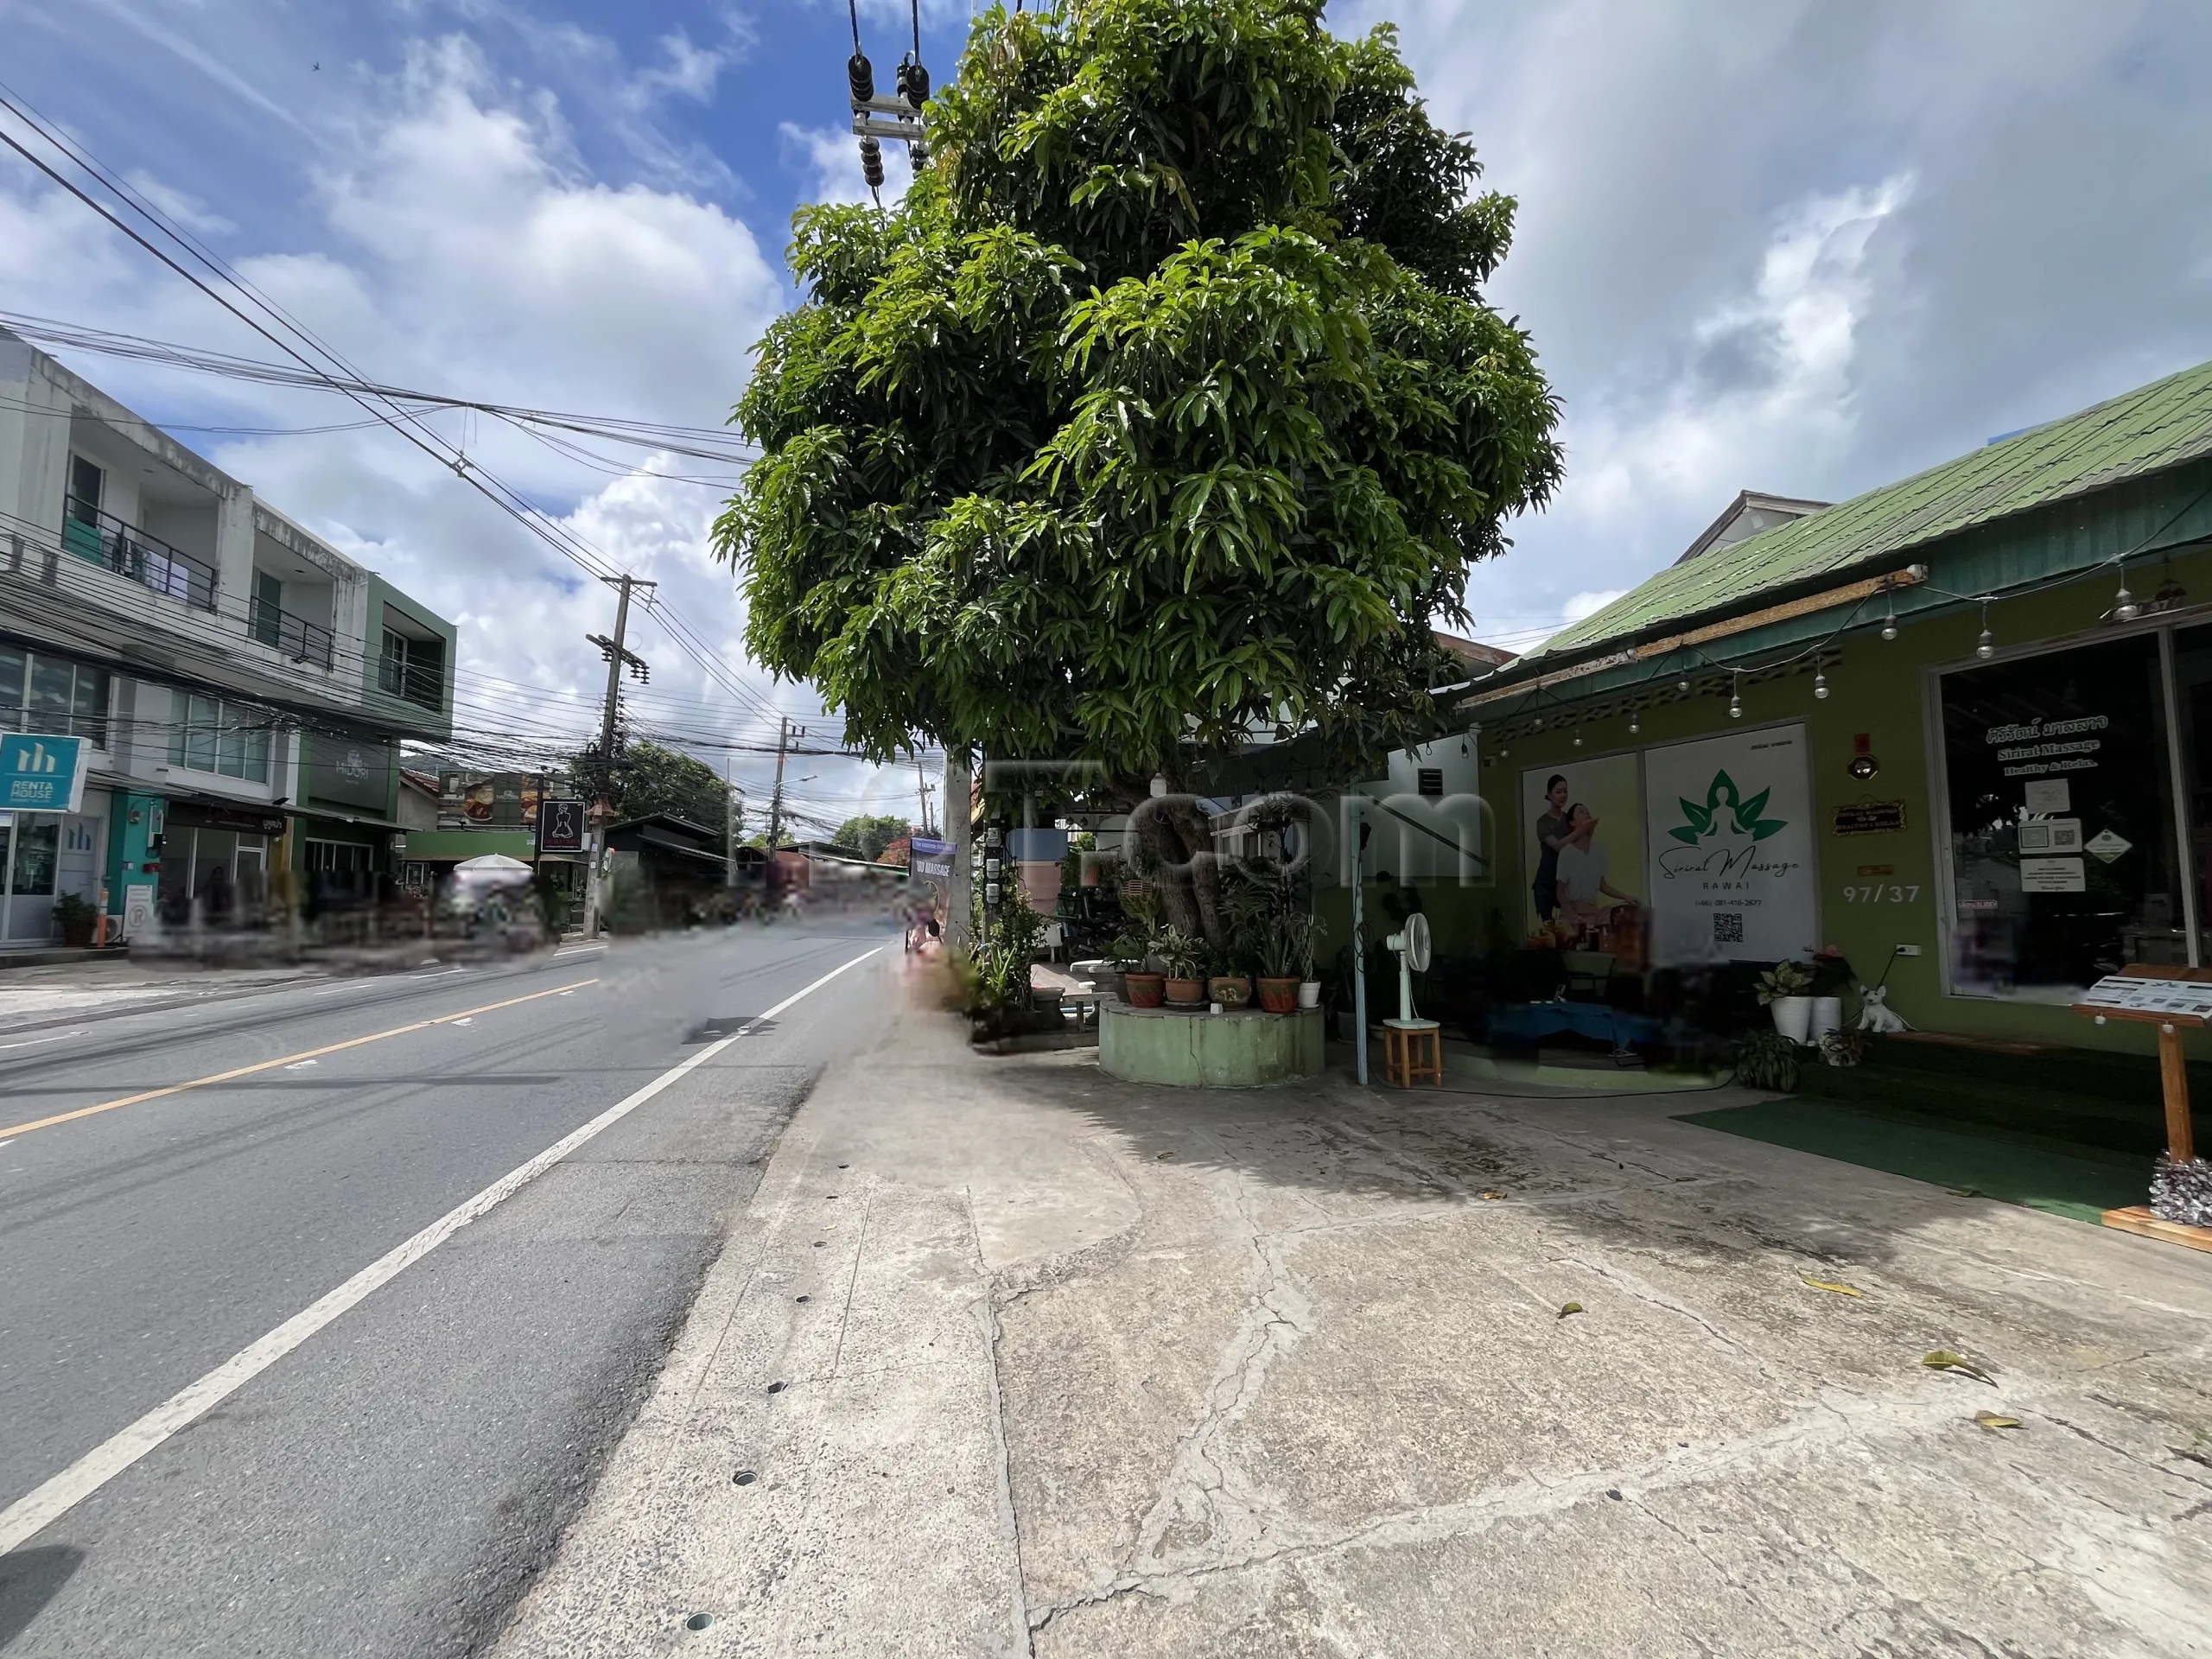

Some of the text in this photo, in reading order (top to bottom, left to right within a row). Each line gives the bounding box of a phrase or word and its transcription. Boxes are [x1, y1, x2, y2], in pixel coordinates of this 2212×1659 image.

[1998, 740, 2101, 761] Sirirat Massage
[2004, 764, 2048, 777] Healthy
[12, 780, 54, 791] RENTA
[10, 789, 54, 799] HOUSE
[925, 861, 950, 877] MASSAGE
[1658, 845, 1800, 879] Sirirat Massage
[1702, 881, 1750, 890] RAWAI
[1842, 883, 1921, 904] 97/37
